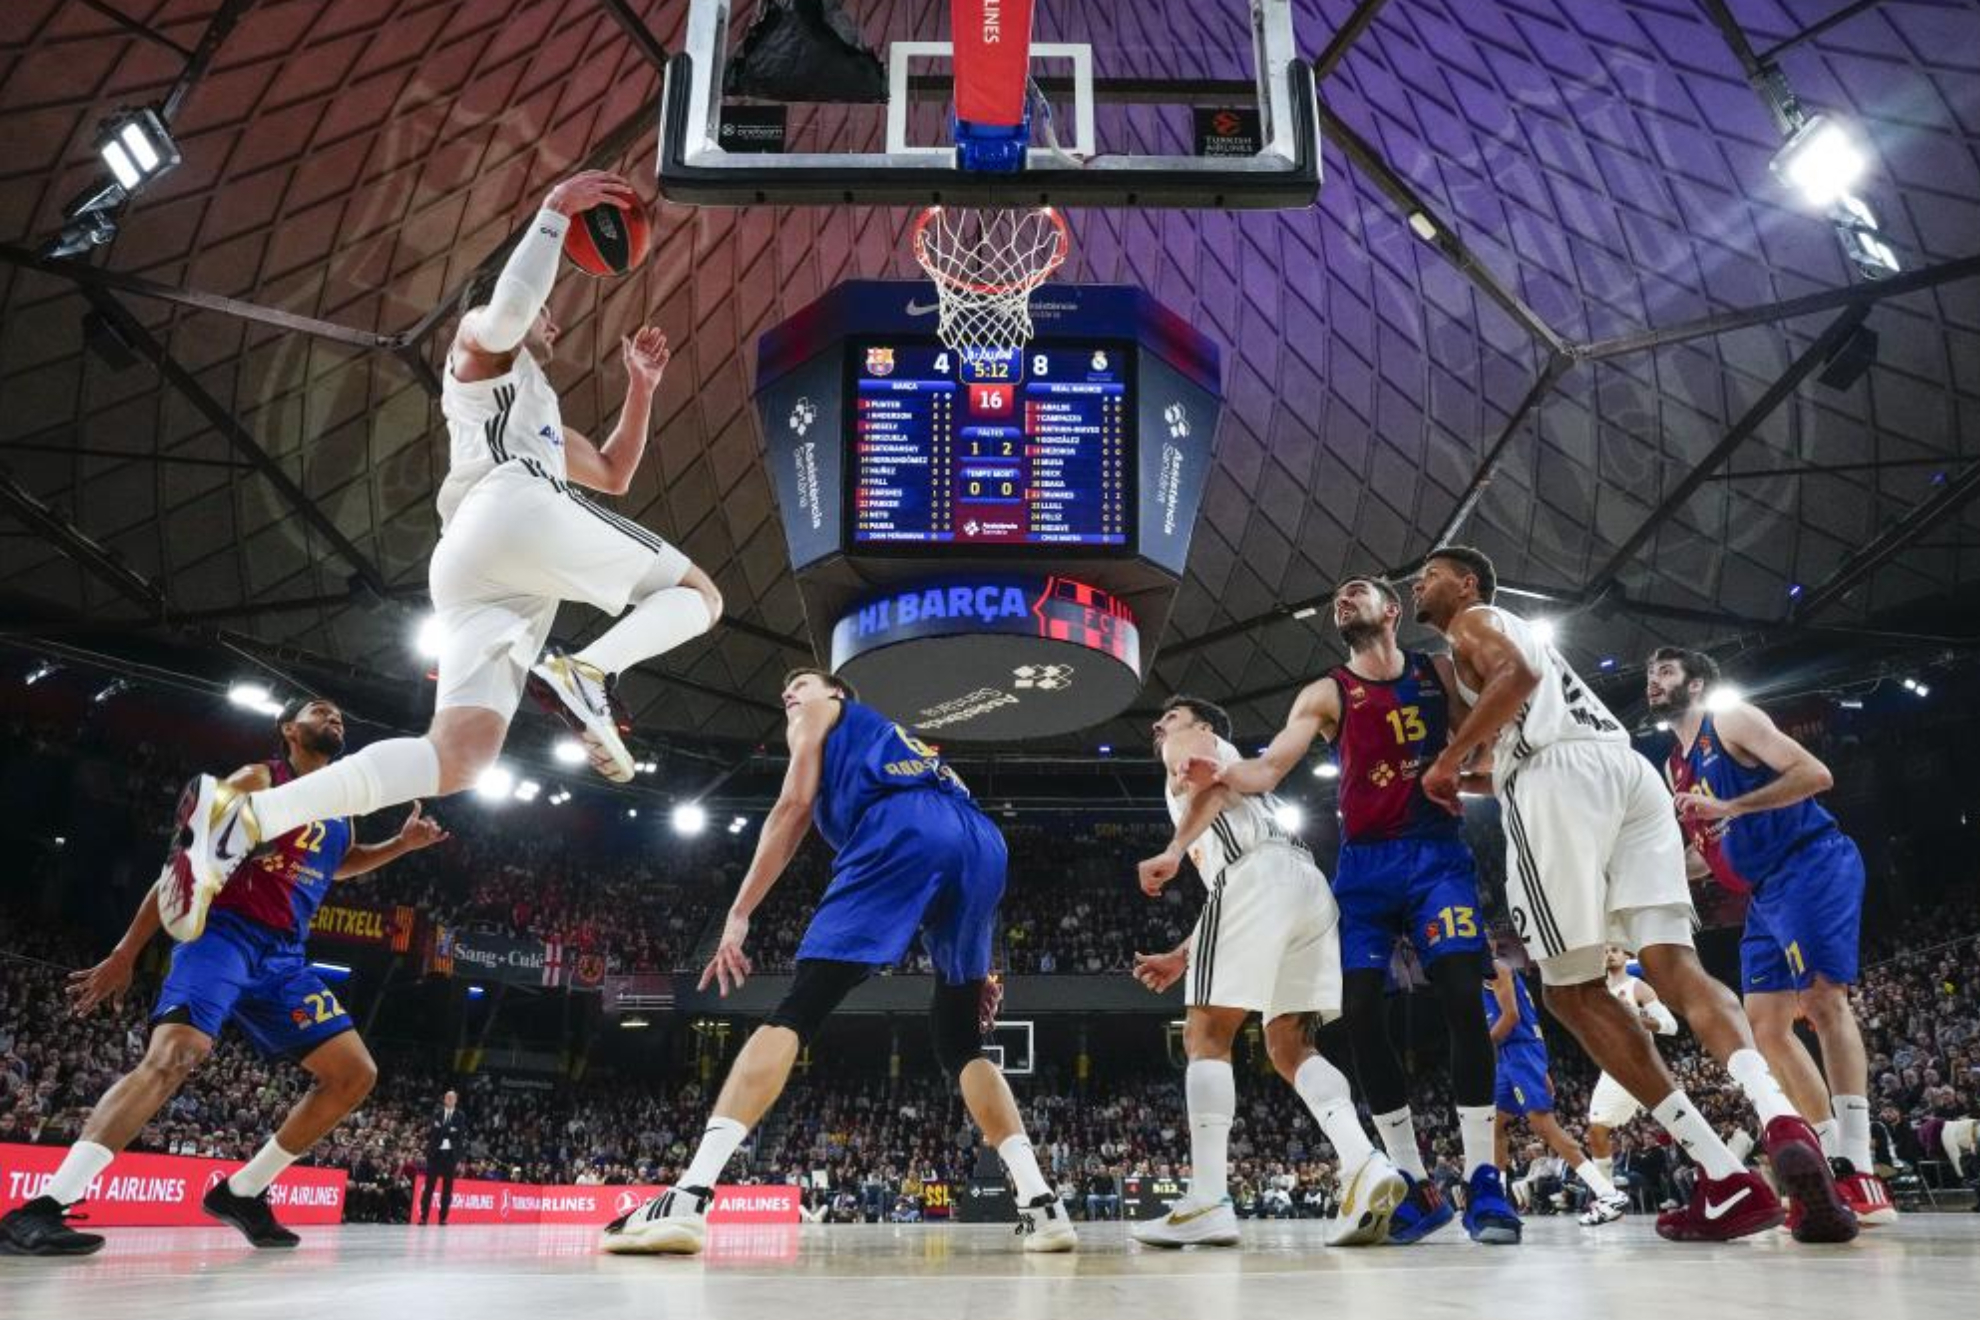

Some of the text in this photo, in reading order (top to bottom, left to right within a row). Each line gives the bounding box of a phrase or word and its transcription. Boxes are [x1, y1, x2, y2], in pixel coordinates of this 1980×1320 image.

[933, 352, 951, 375] 4
[974, 361, 1009, 379] 5:12
[1033, 354, 1049, 376] 8
[979, 390, 1003, 409] 16
[970, 441, 1013, 456] 1 2
[969, 481, 1013, 496] 0 0
[897, 585, 1029, 625] BARÇA
[1385, 704, 1428, 746] 13
[293, 819, 326, 854] 22
[1437, 906, 1478, 939] 13
[454, 943, 497, 969] Sang
[302, 989, 348, 1025] 22
[9, 1172, 187, 1203] TURH AIRLINES
[288, 1186, 340, 1206] AIRLINES
[719, 1197, 791, 1212] AIRLINES
